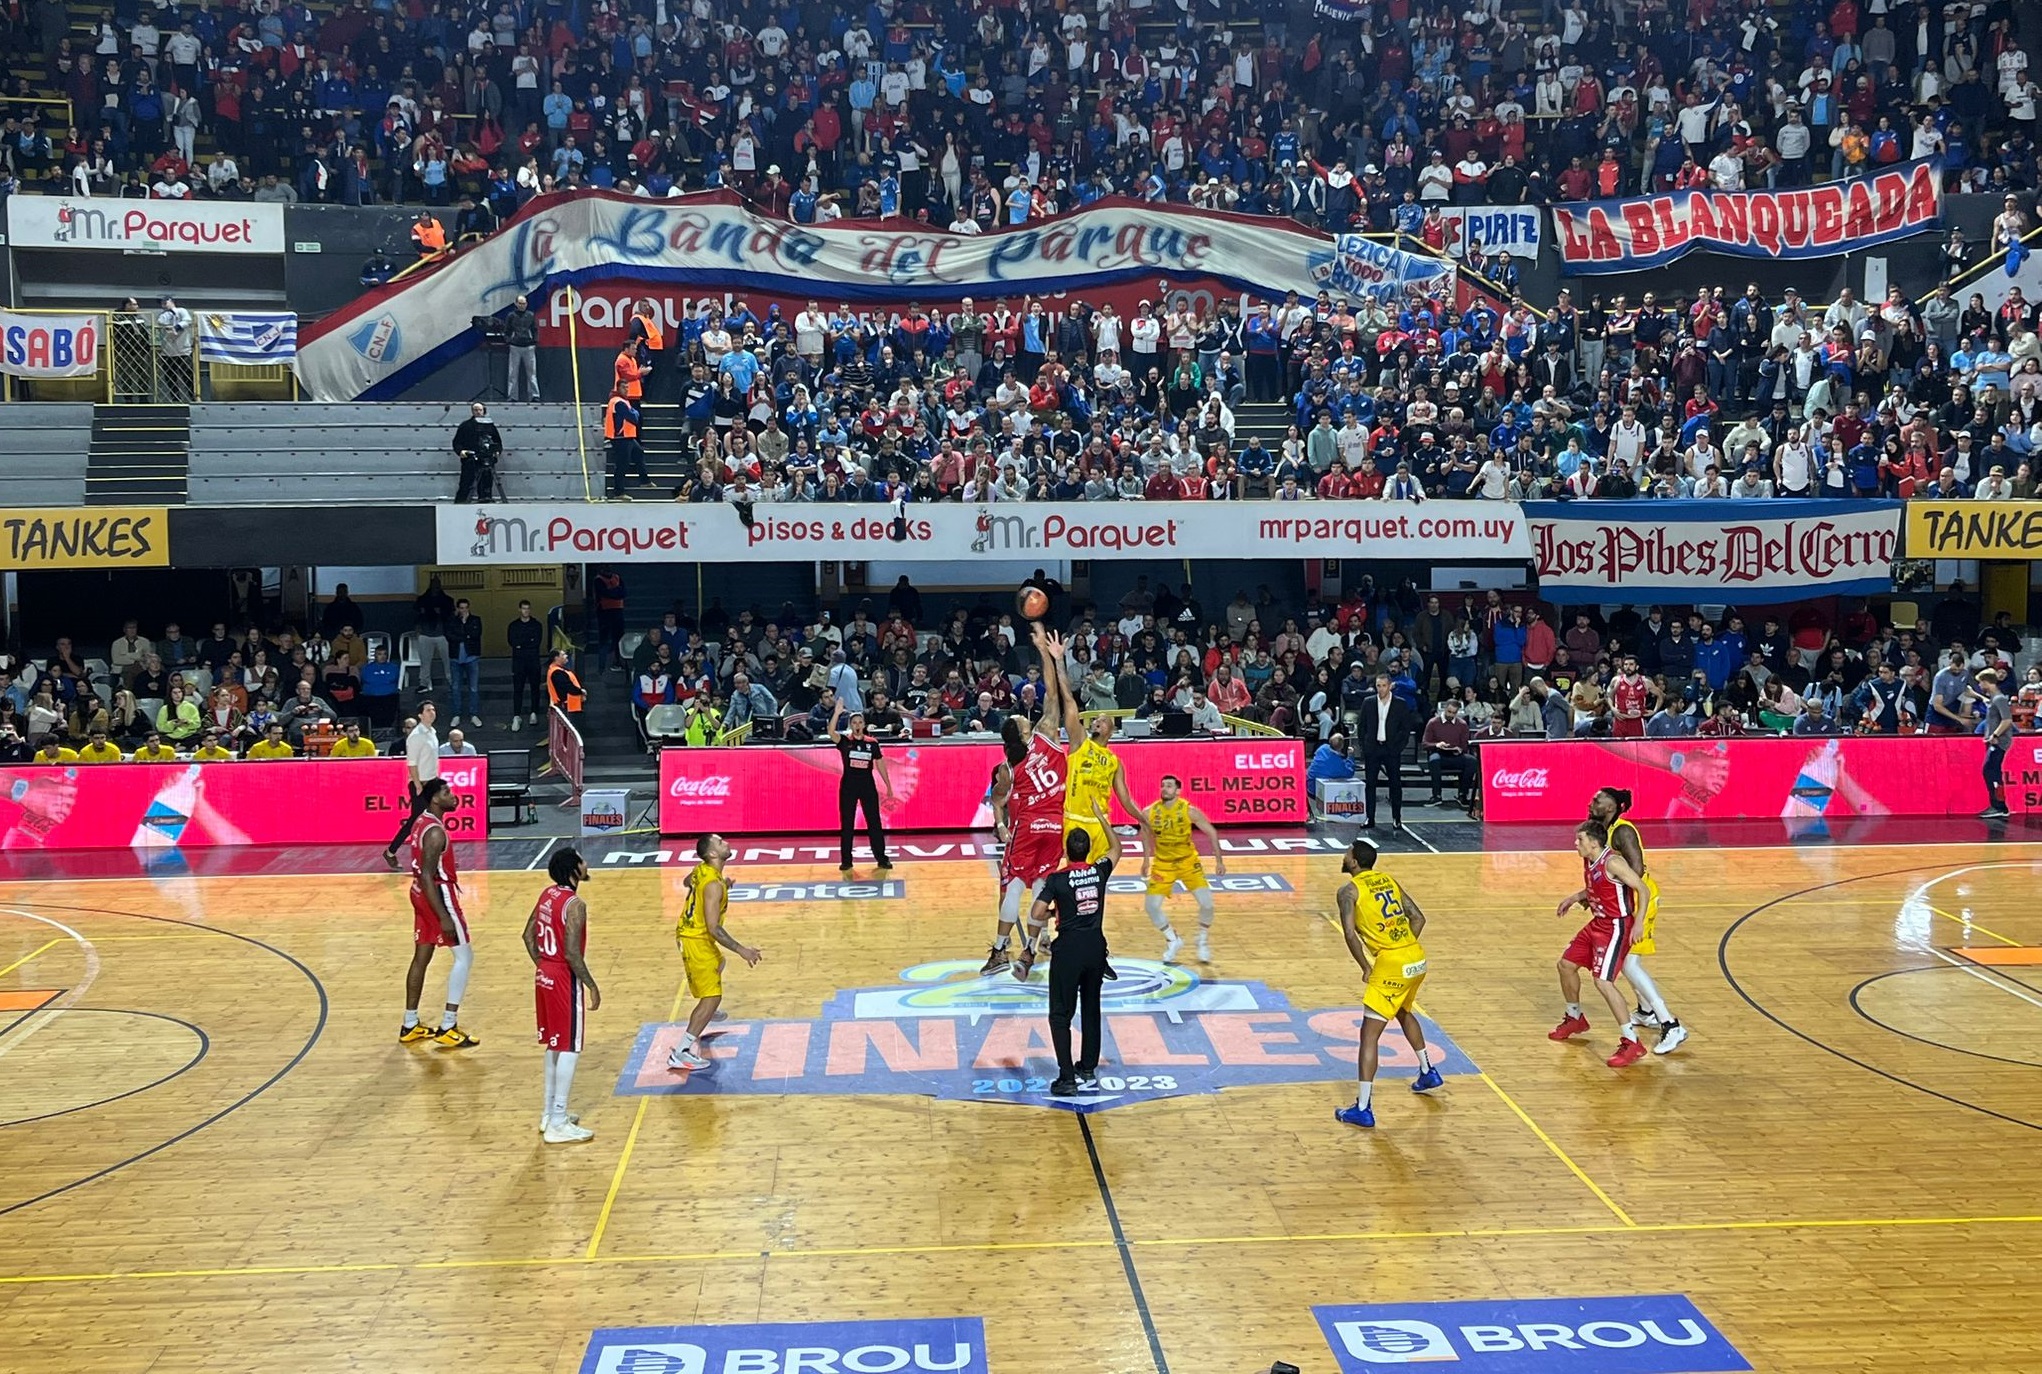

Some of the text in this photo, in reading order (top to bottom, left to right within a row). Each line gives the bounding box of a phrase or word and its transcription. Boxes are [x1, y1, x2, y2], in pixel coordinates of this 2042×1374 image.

[1556, 163, 1937, 261] LA BLANQUEADA
[1345, 256, 1384, 283] TODO
[0, 319, 97, 369] SABÓ
[4, 517, 151, 561] TANKES
[748, 516, 825, 547] pisos
[831, 521, 845, 541] &
[1259, 514, 1515, 544] mrparquet.com.uy
[1923, 510, 2042, 551] TANKE
[1532, 521, 1897, 583] Los Pibes Del Cerro
[1234, 750, 1295, 770] ELEGÍ
[441, 767, 478, 787] EGÍ
[1026, 767, 1059, 793] 16
[1190, 776, 1296, 792] EL MEJOR
[365, 796, 391, 811] EL
[1224, 798, 1297, 813] SABOR
[1325, 802, 1365, 814] FINALES
[582, 814, 623, 826] FINALES
[1375, 889, 1403, 919] 25
[634, 1010, 1446, 1088] FINALES
[1458, 1319, 1709, 1353] BROU
[722, 1342, 972, 1374] BROU
